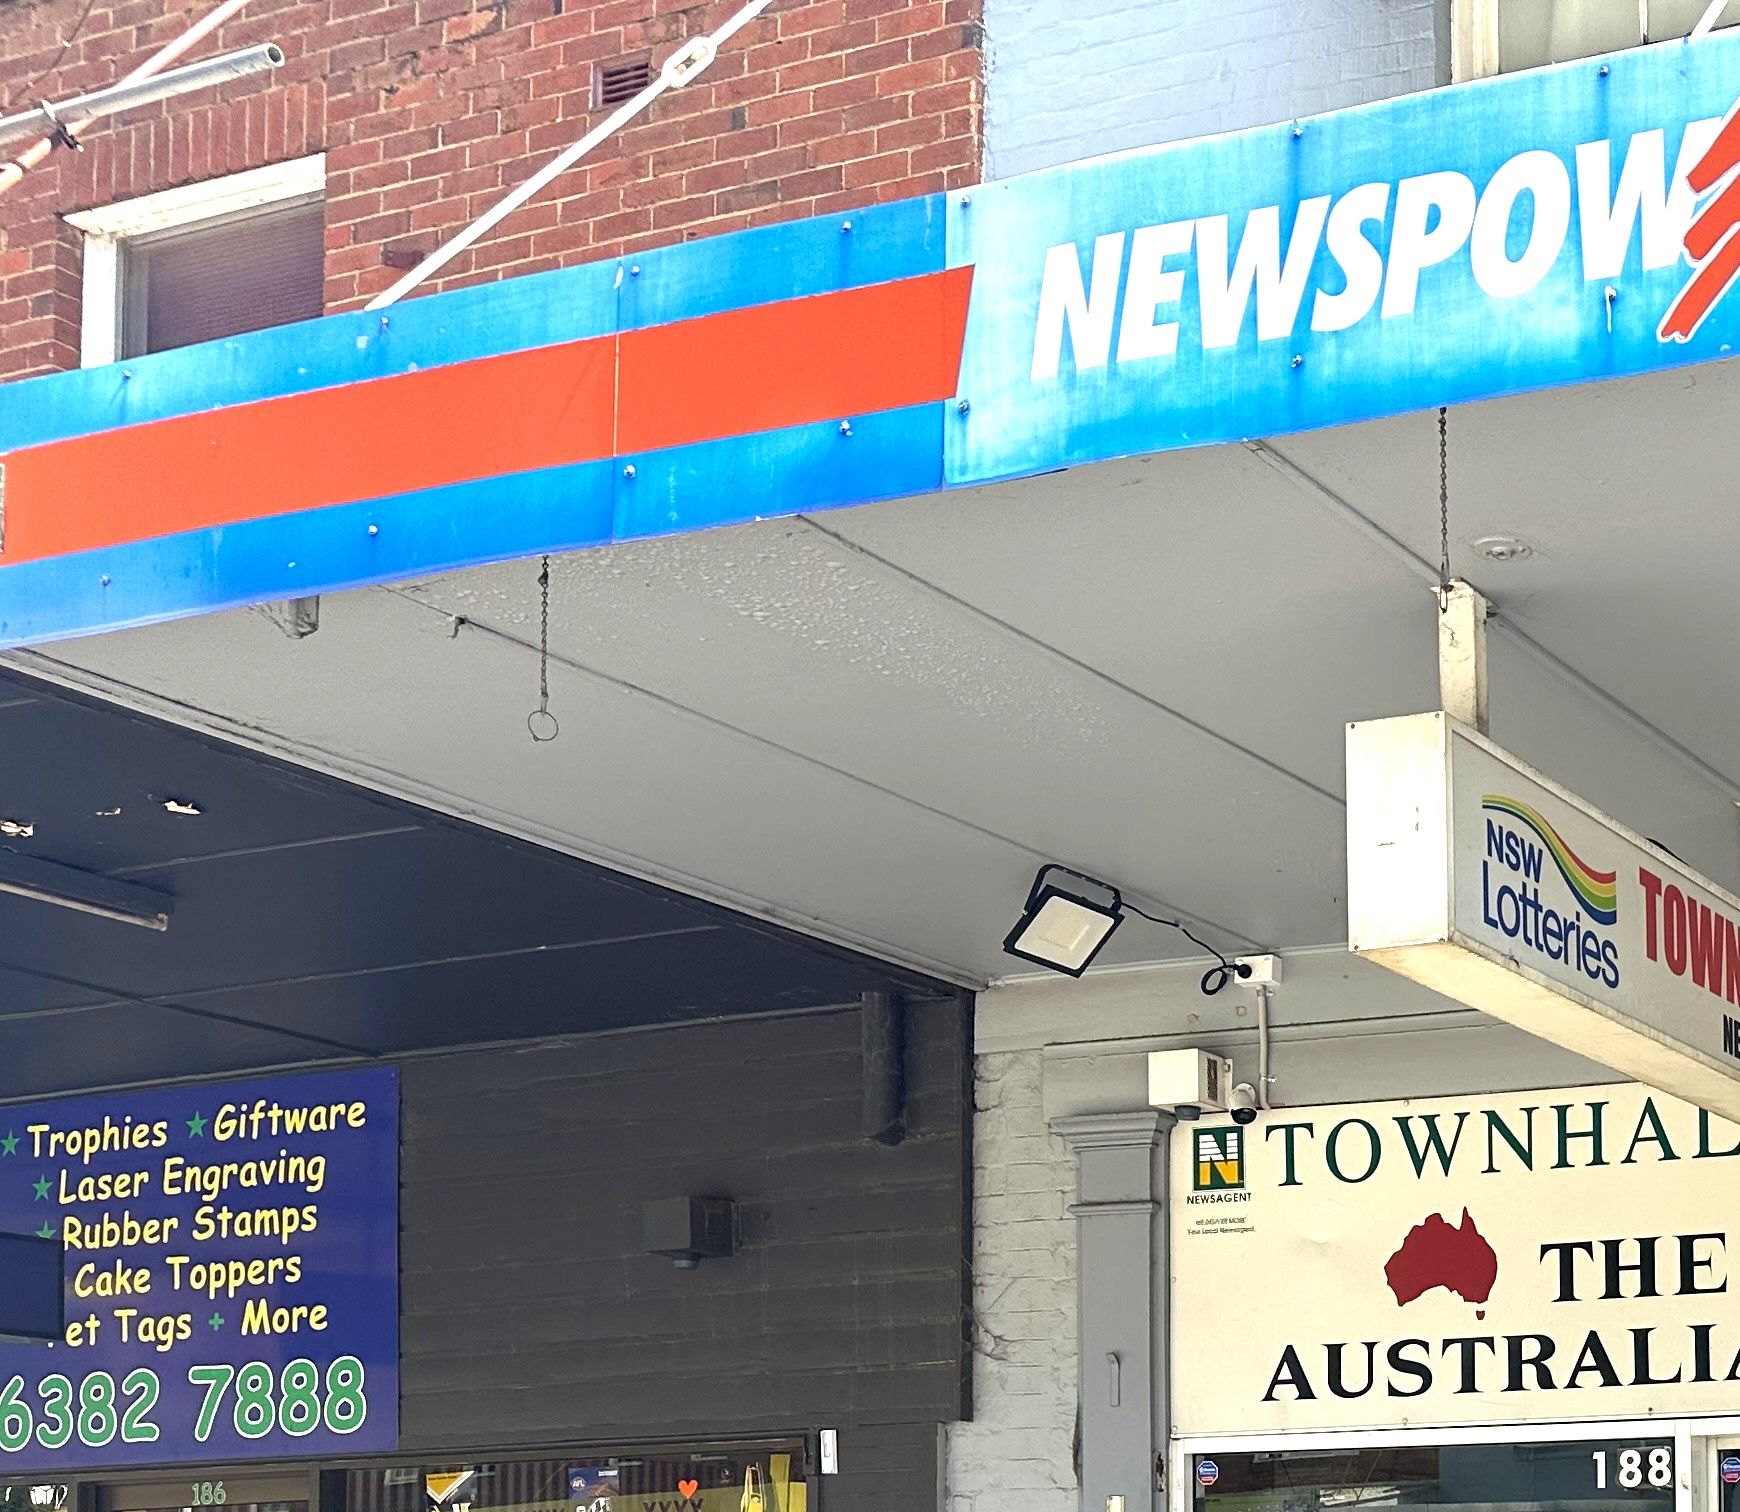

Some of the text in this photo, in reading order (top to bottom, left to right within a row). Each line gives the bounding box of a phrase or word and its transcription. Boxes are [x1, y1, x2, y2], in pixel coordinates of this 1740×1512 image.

[1487, 819, 1543, 883] NSW
[1482, 859, 1619, 989] Lotteries
[27, 1100, 367, 1164] Trophies Giftware
[58, 1149, 327, 1206] Laser Engraving
[1187, 1192, 1252, 1205] NEWSAGENT
[63, 1203, 318, 1251] Rubber Stamps
[74, 1255, 302, 1300] Cake Toppers
[1539, 1232, 1728, 1303] THE
[48, 1298, 328, 1352] et Tags More
[0, 1355, 368, 1452] 6382 7888
[192, 1481, 227, 1506] 186
[1592, 1447, 1673, 1489] 188
